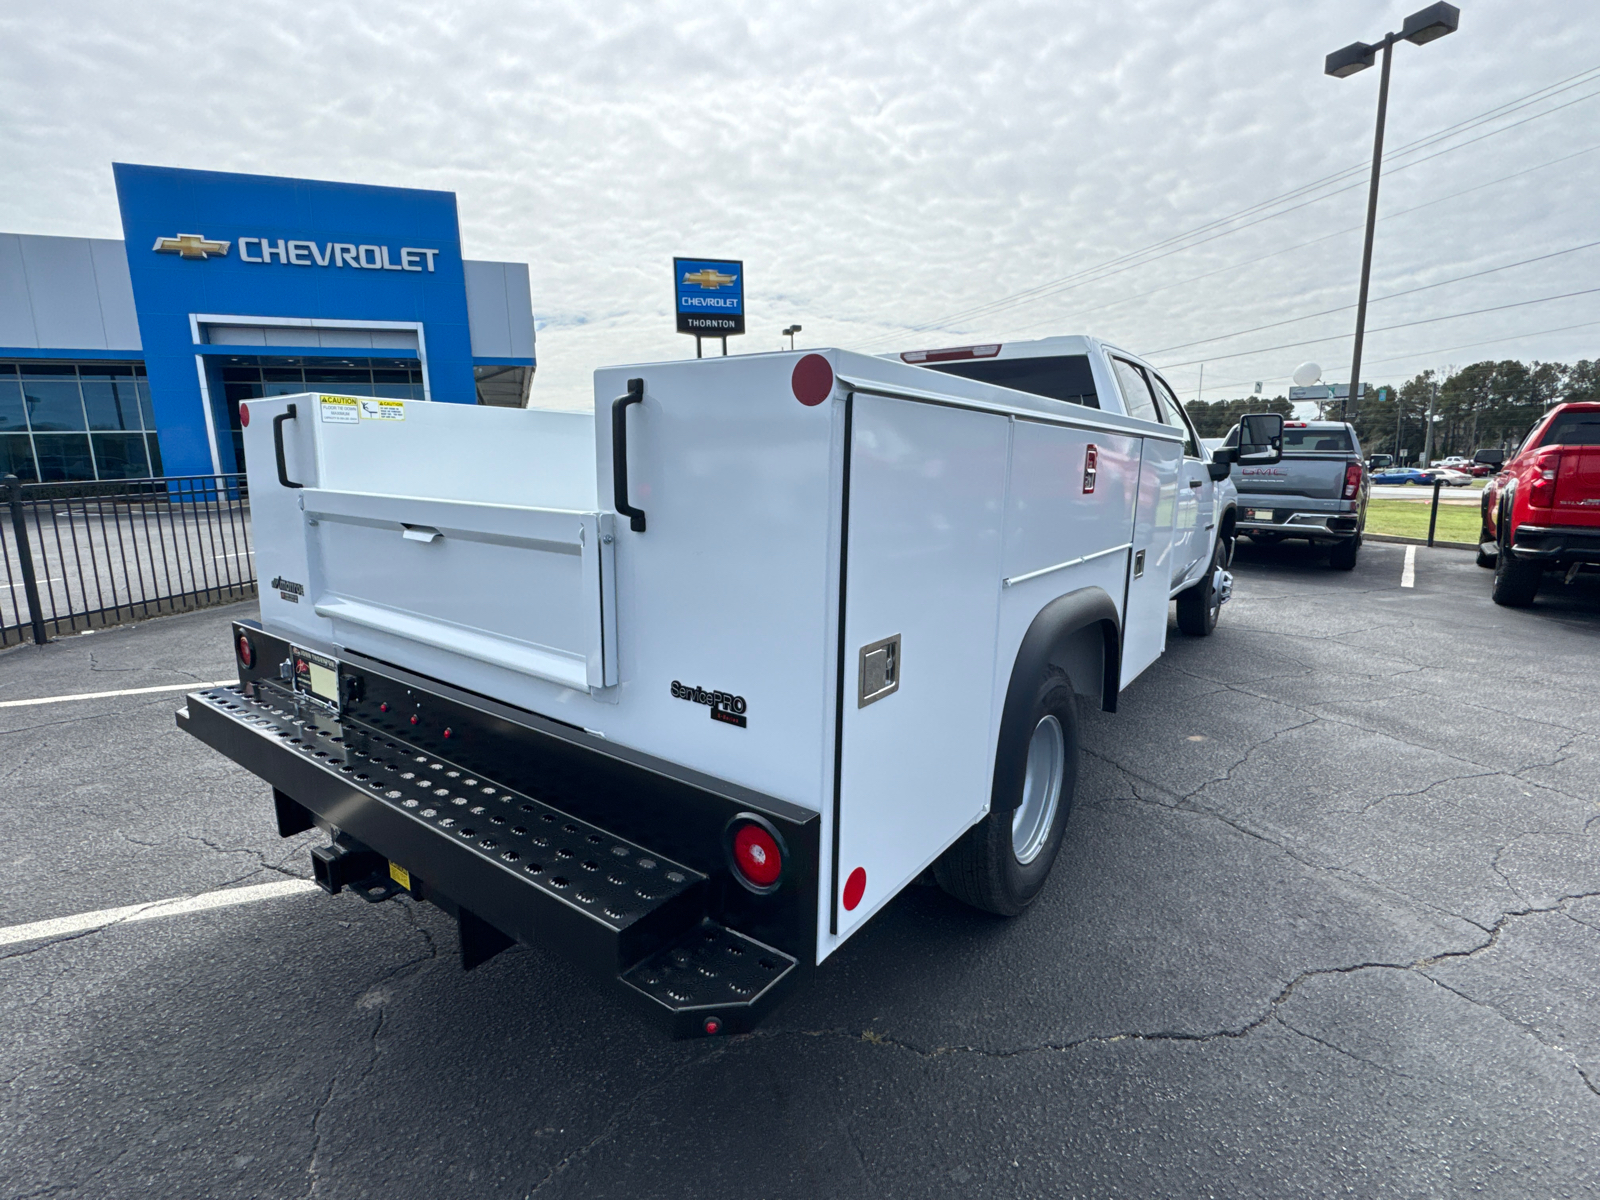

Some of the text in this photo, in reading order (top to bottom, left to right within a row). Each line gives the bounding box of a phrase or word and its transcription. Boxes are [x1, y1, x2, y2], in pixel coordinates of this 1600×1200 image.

[238, 237, 439, 272] CHEVROLET
[682, 297, 738, 307] CHEVROLET
[688, 319, 735, 328] THORNTON
[328, 397, 357, 405] CAUTION
[1242, 467, 1288, 476] GMC
[670, 680, 747, 714] ServicePRO
